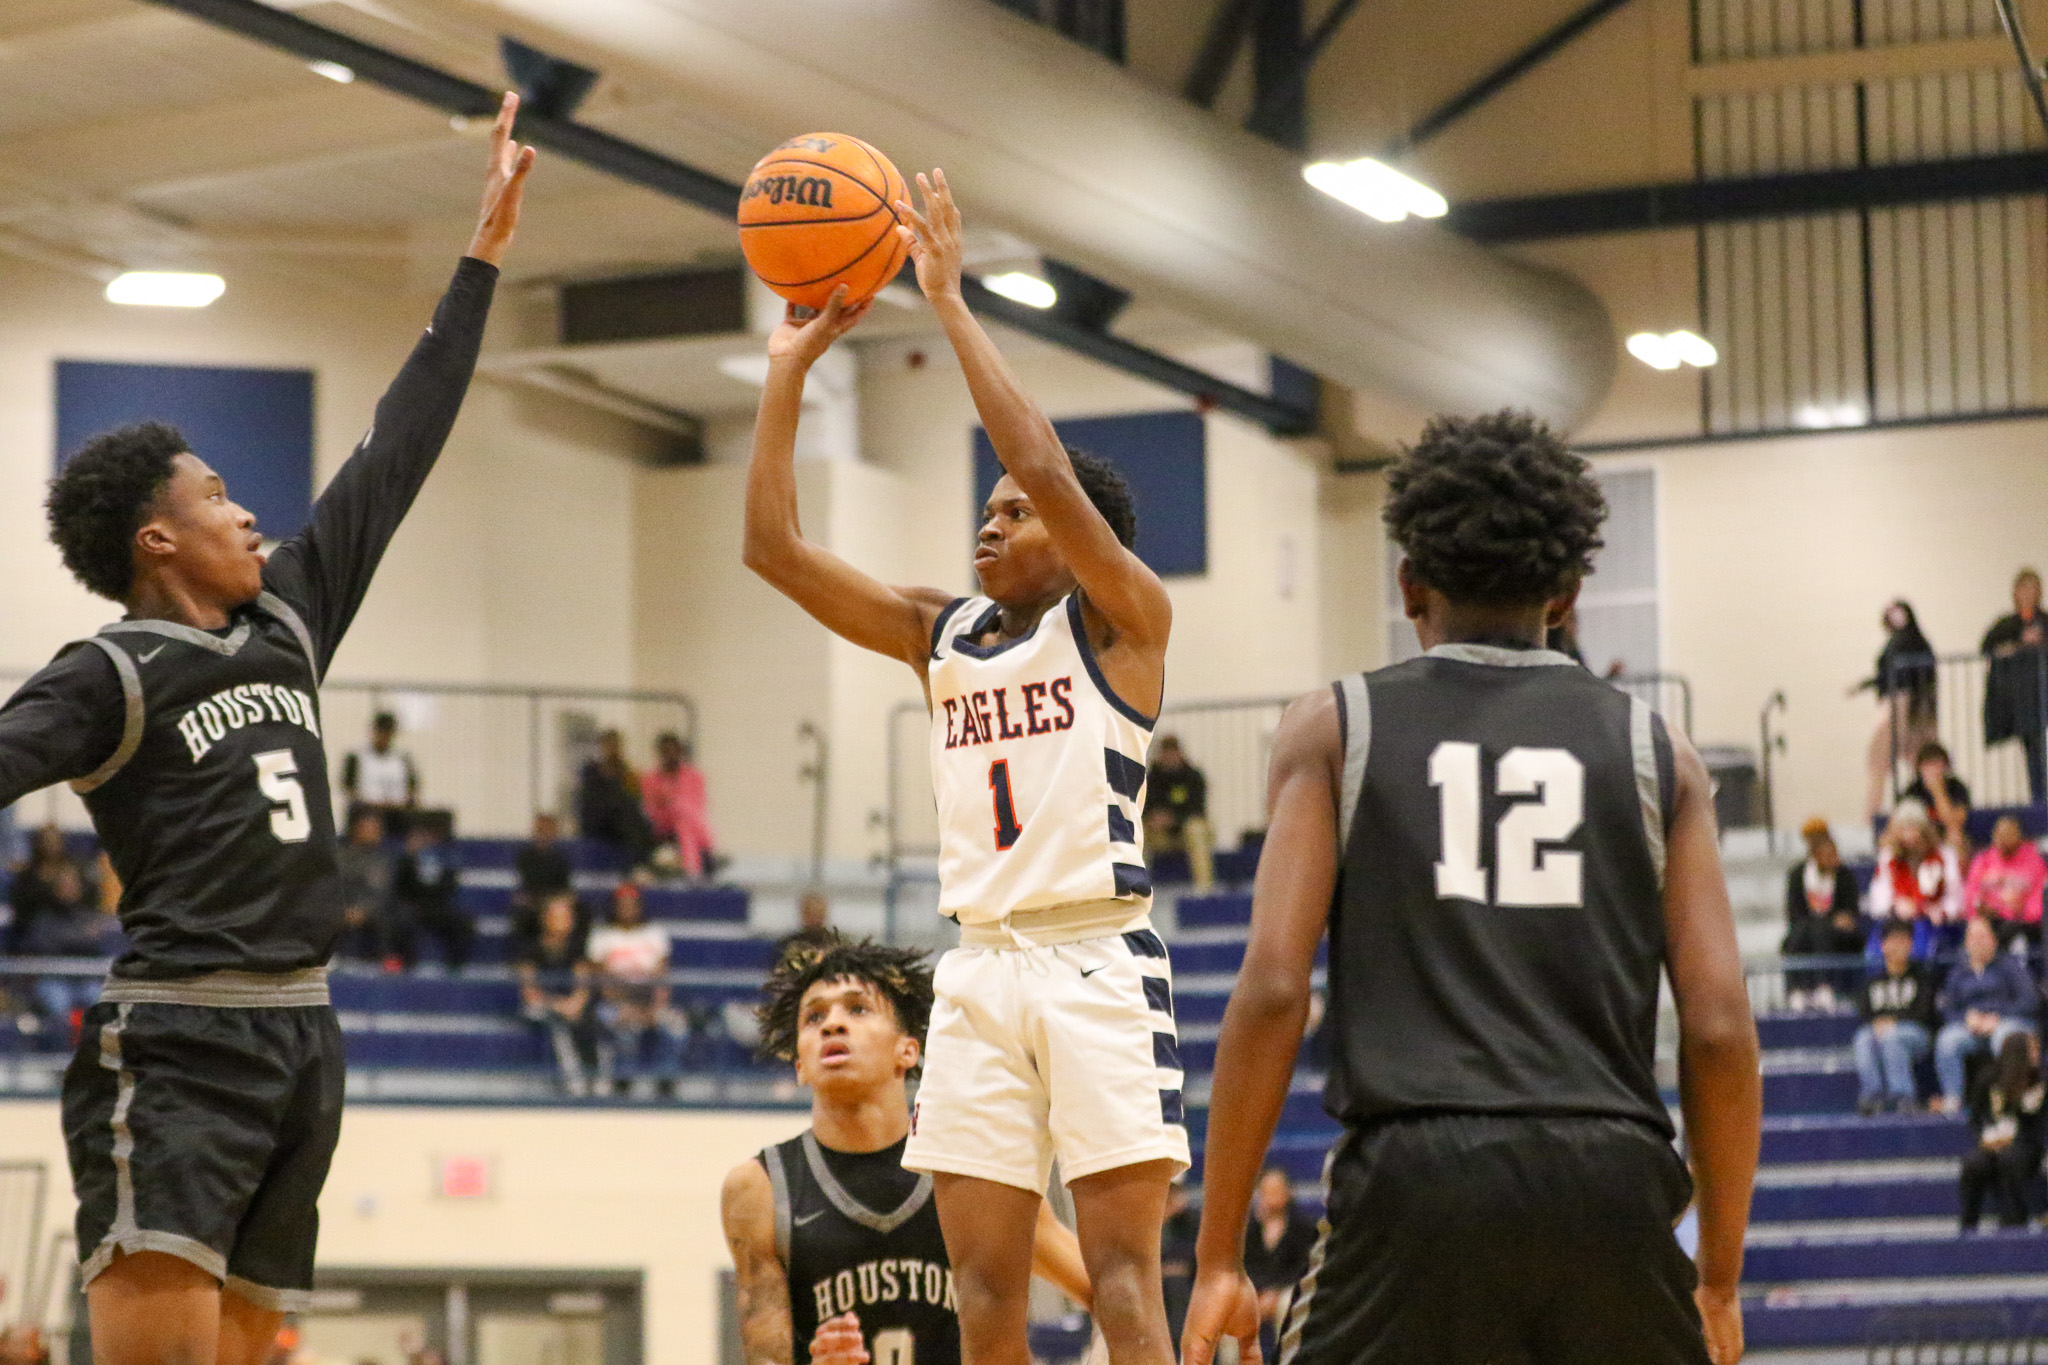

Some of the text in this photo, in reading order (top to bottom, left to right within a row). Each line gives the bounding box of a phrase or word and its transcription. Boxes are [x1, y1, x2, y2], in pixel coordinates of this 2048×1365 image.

[177, 683, 320, 764] HOUSTON
[942, 676, 1075, 750] EAGLES
[251, 749, 312, 844] 5
[989, 758, 1023, 851] 1
[1427, 741, 1586, 909] 12
